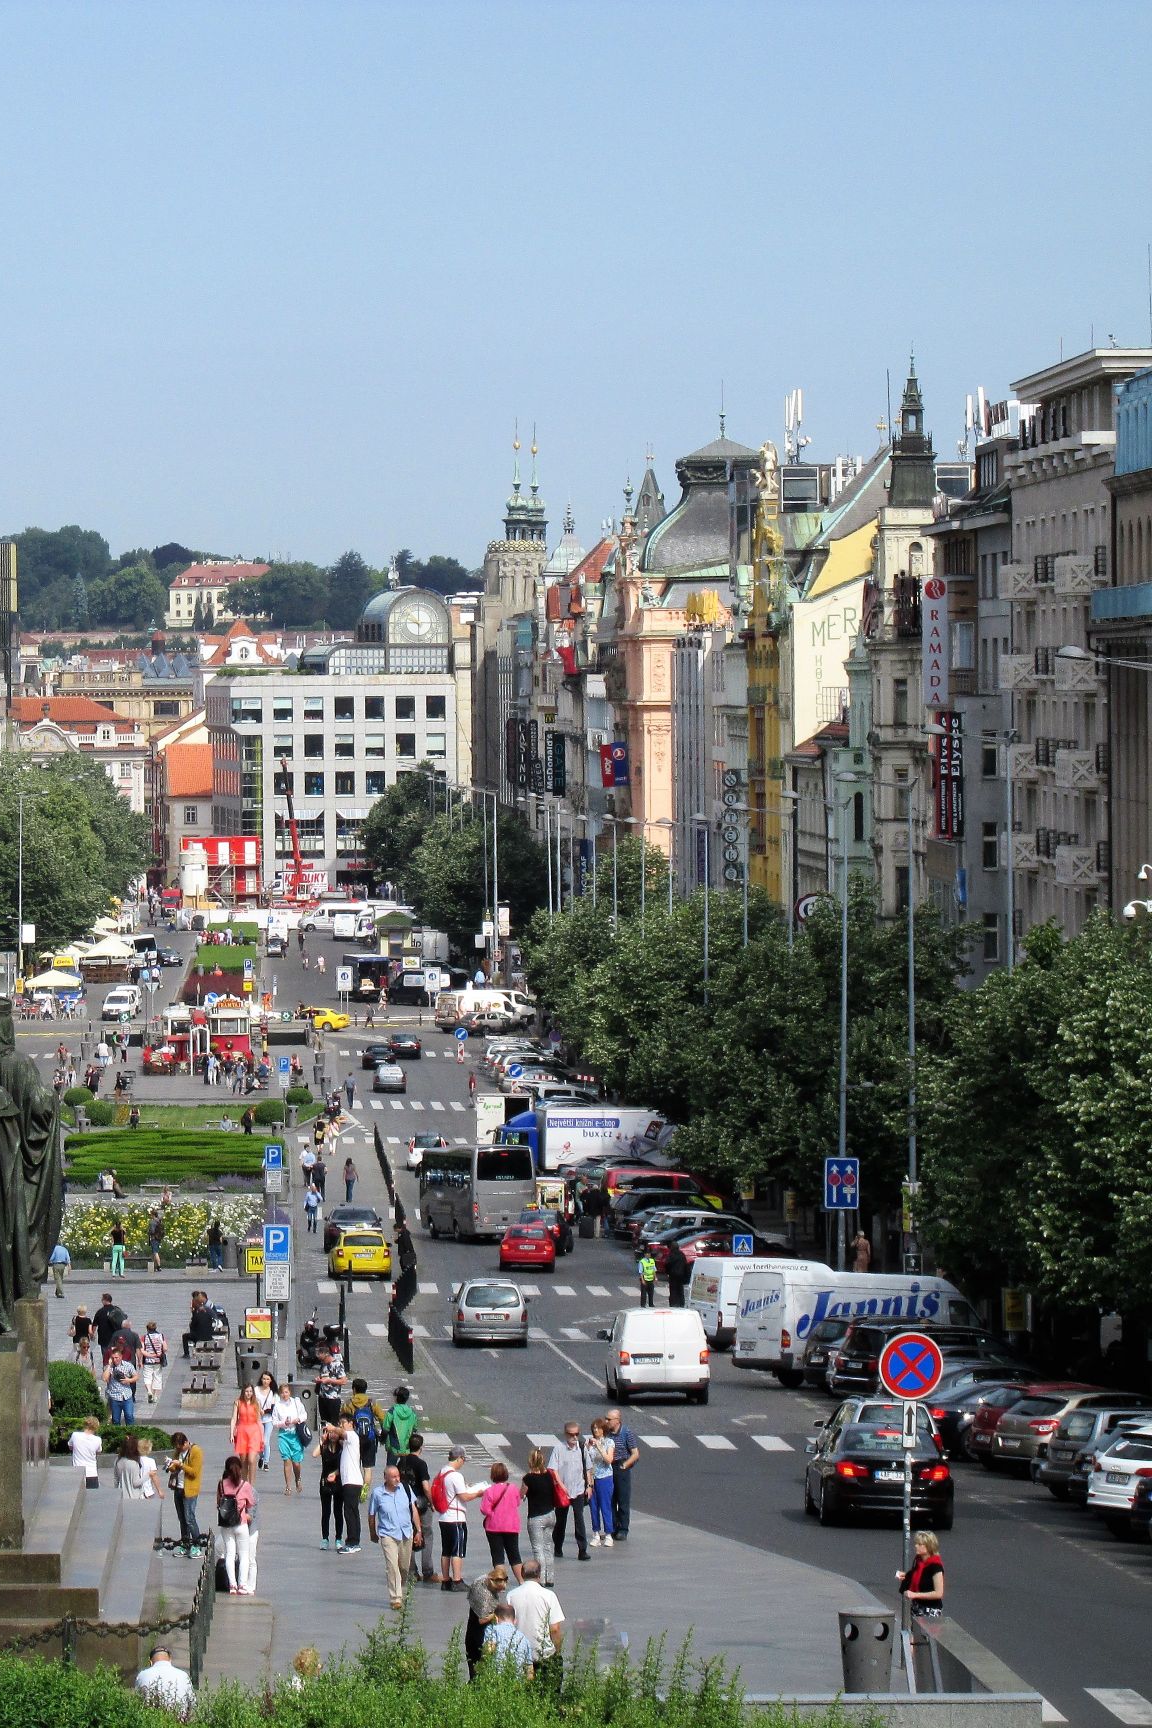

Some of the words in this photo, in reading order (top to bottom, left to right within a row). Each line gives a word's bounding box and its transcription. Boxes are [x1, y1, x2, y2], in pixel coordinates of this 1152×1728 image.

[929, 609, 942, 703] RAMADA
[281, 1059, 287, 1068] P
[595, 1118, 616, 1129] e-shop
[582, 1129, 613, 1138] bux.cz
[268, 1149, 278, 1163] P
[269, 1229, 284, 1251] P
[741, 1289, 781, 1318] Jannis
[796, 1281, 941, 1340] Jannis
